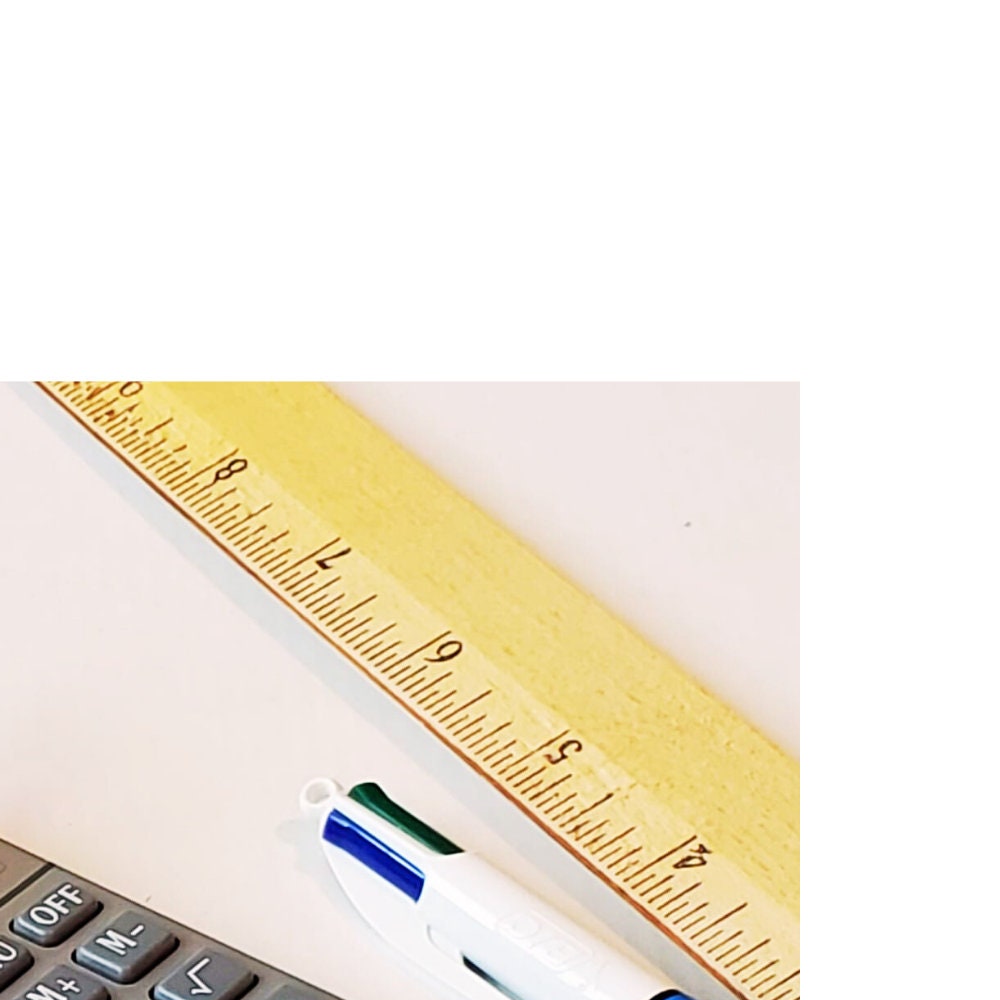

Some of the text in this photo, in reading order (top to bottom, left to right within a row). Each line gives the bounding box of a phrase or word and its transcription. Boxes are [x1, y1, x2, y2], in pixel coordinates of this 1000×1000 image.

[214, 458, 248, 482] 8
[316, 547, 352, 570] 7
[424, 640, 463, 663] 6
[547, 739, 583, 765] 5
[673, 843, 713, 869] 4
[29, 883, 84, 926] OFF
